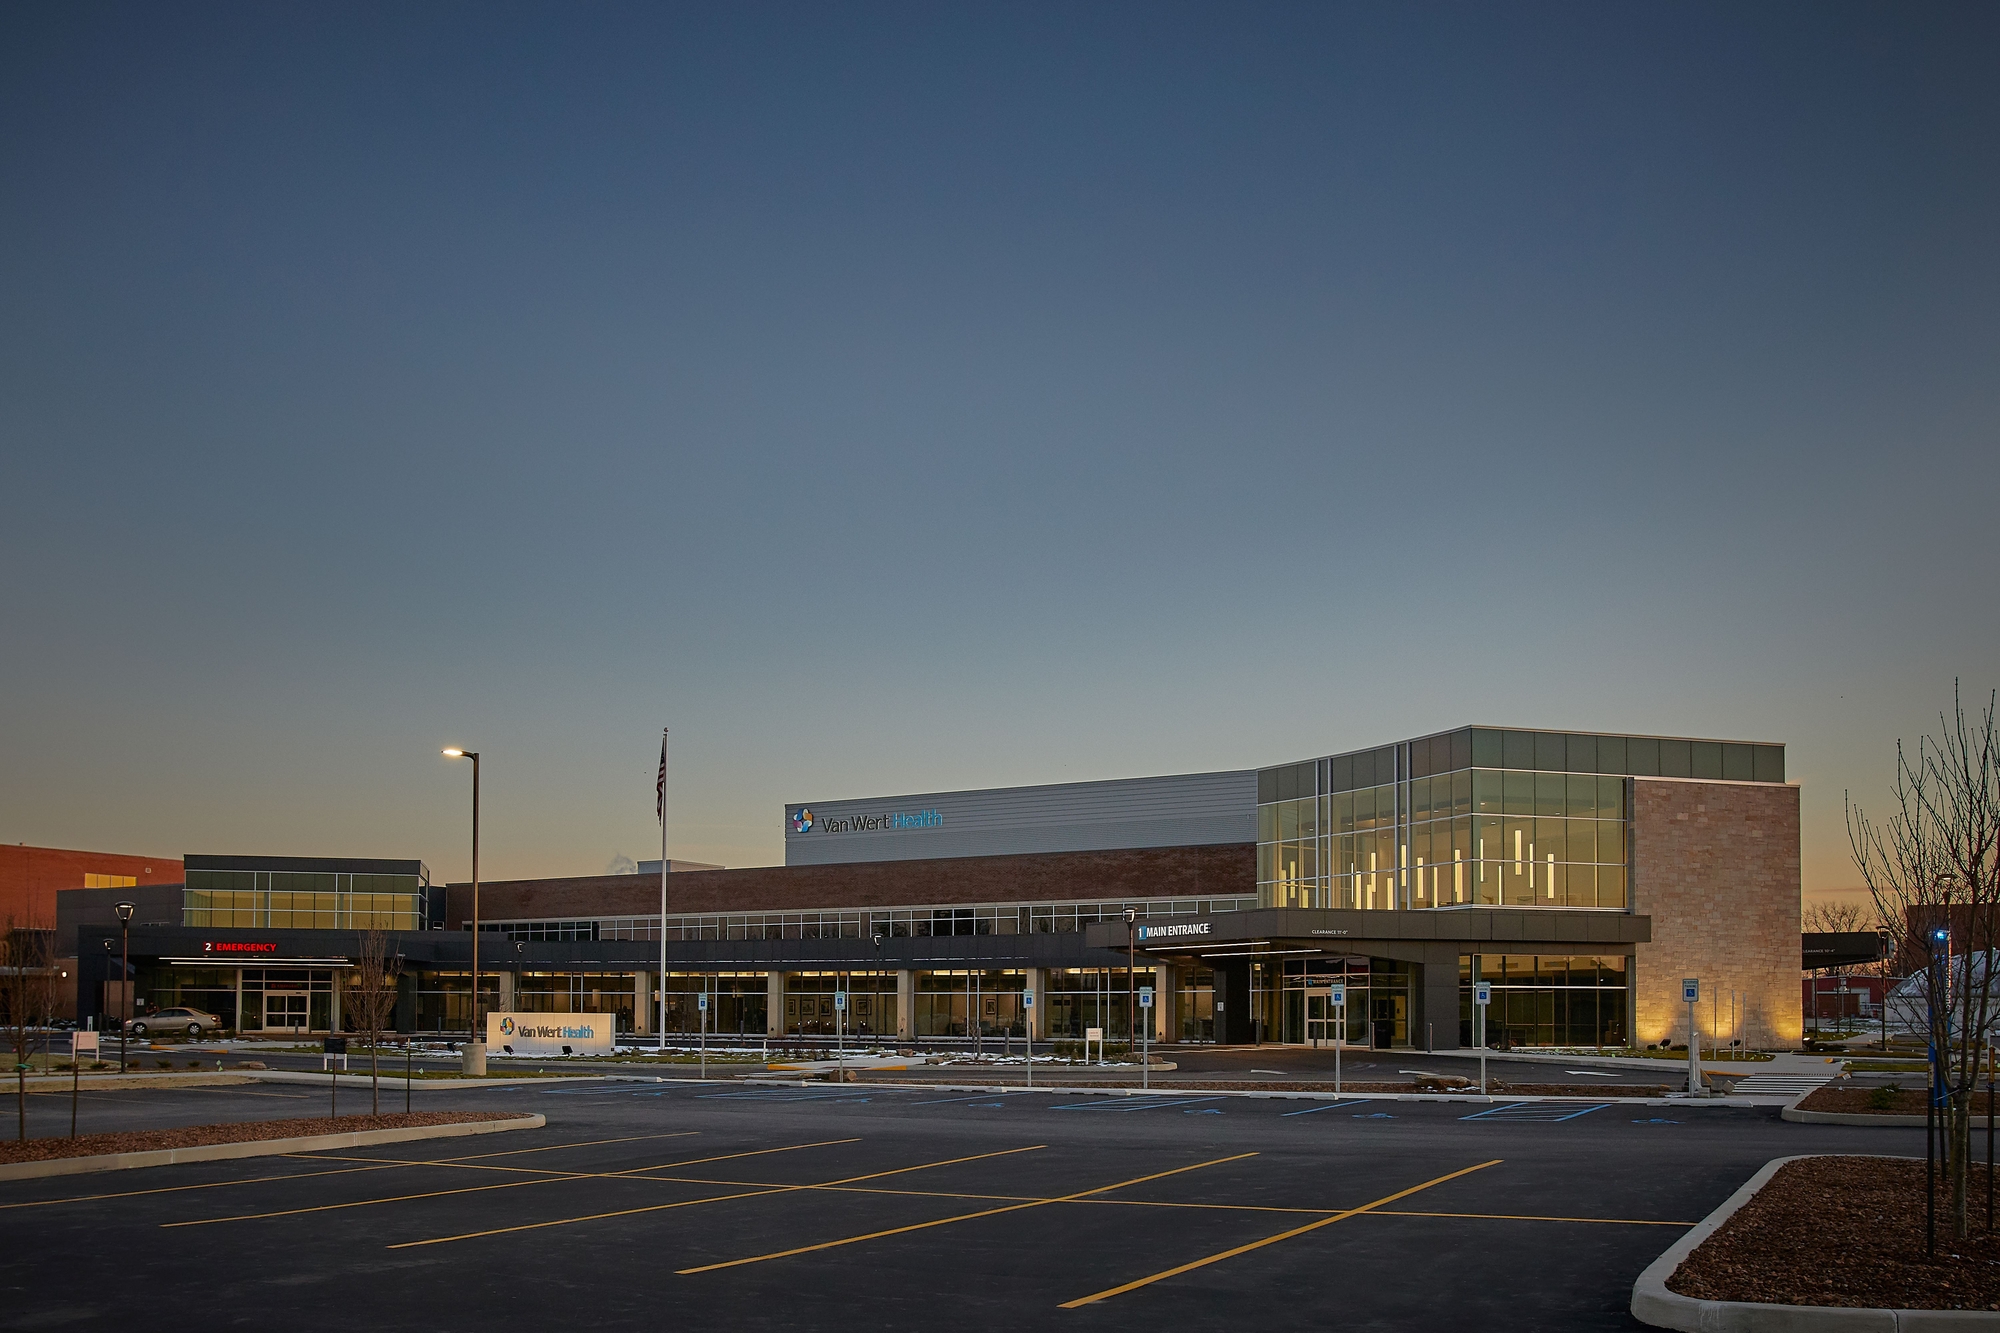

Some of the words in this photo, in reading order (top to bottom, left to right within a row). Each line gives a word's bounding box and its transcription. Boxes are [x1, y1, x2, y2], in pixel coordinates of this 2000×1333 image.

[822, 817, 849, 833] Van
[851, 814, 890, 832] Wert
[893, 808, 943, 830] Health
[1146, 926, 1167, 938] MAIN
[1168, 923, 1210, 936] ENTRANCE
[205, 942, 212, 951] 2
[216, 943, 277, 952] EMERGENCY
[518, 1025, 536, 1038] Van
[537, 1025, 563, 1038] Wert
[563, 1024, 594, 1039] Health
